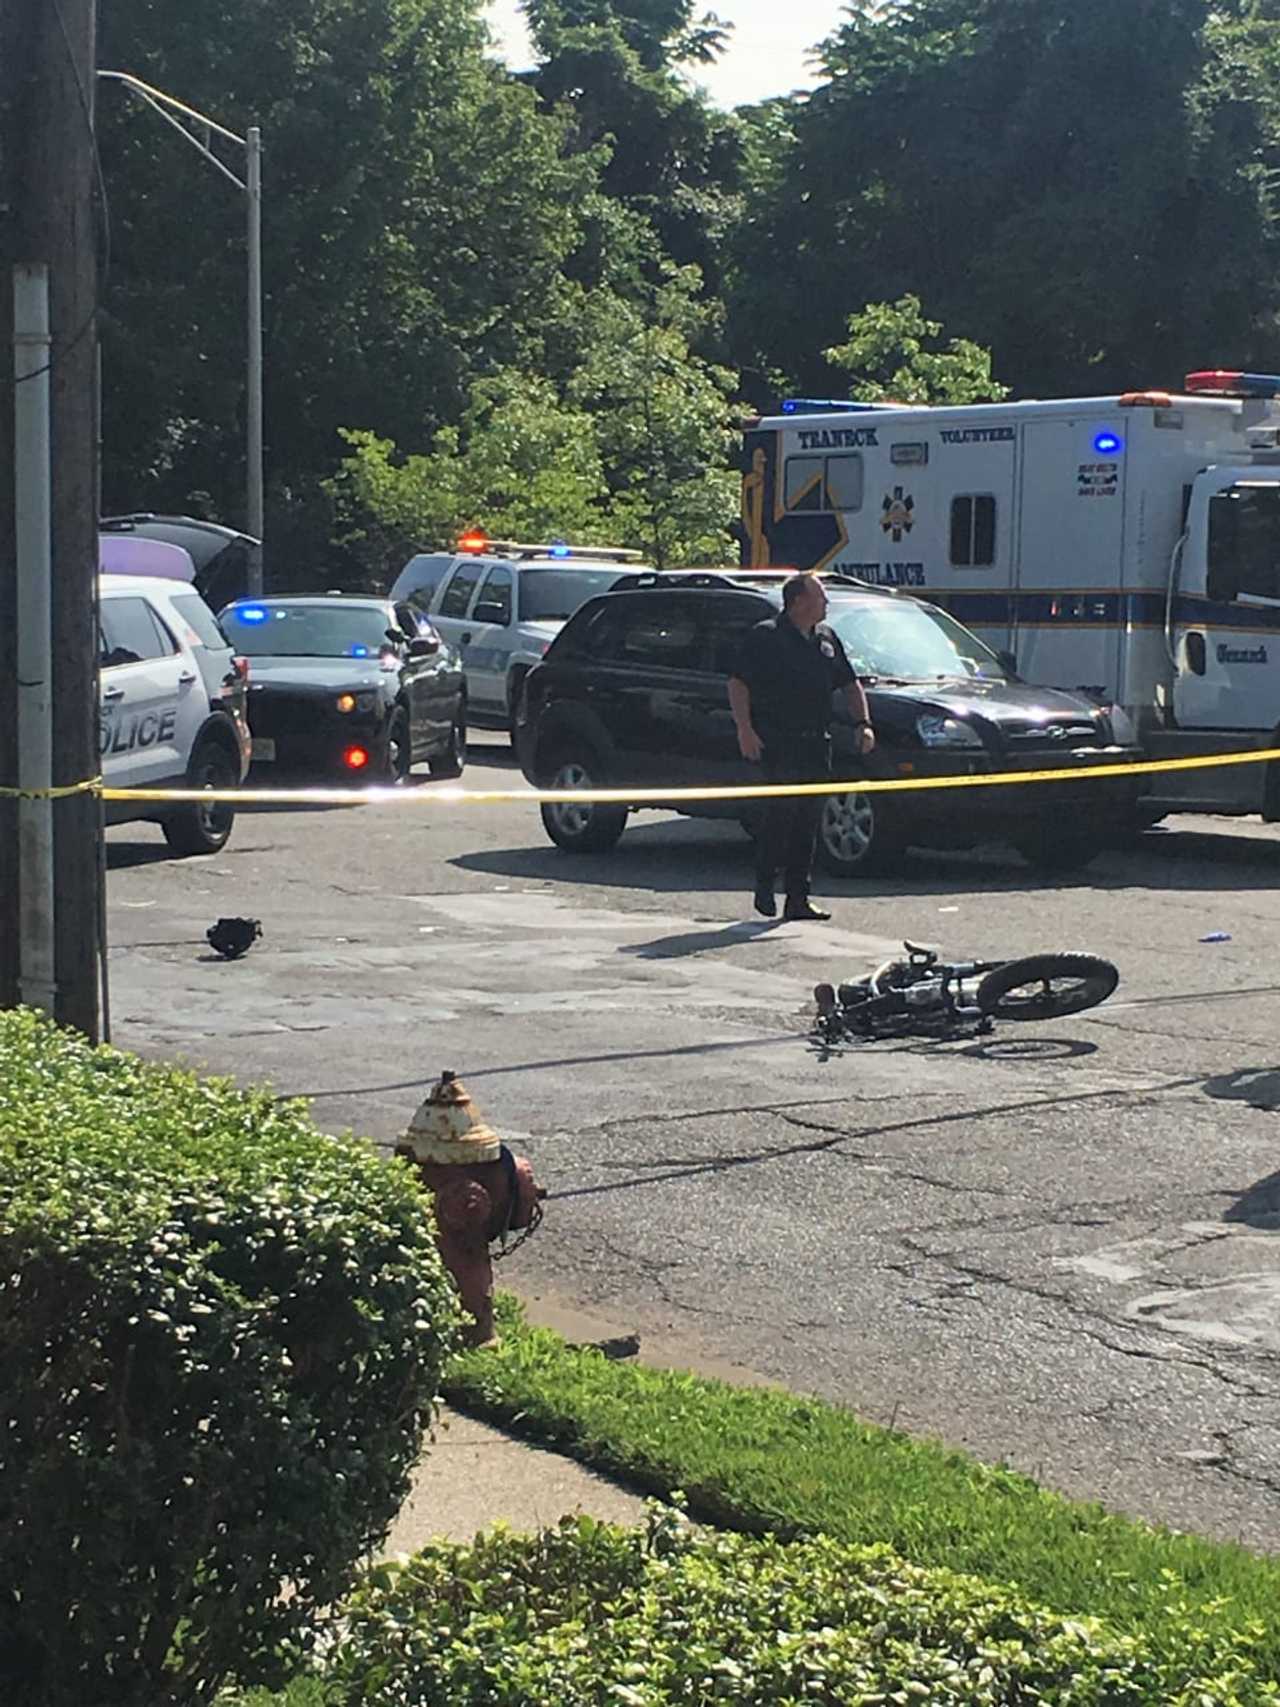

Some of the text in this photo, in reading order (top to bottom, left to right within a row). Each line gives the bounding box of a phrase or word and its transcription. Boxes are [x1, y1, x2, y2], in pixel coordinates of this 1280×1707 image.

[800, 428, 878, 448] TEANECK
[940, 427, 1016, 443] VOLUNTEER
[100, 710, 176, 754] OLICE
